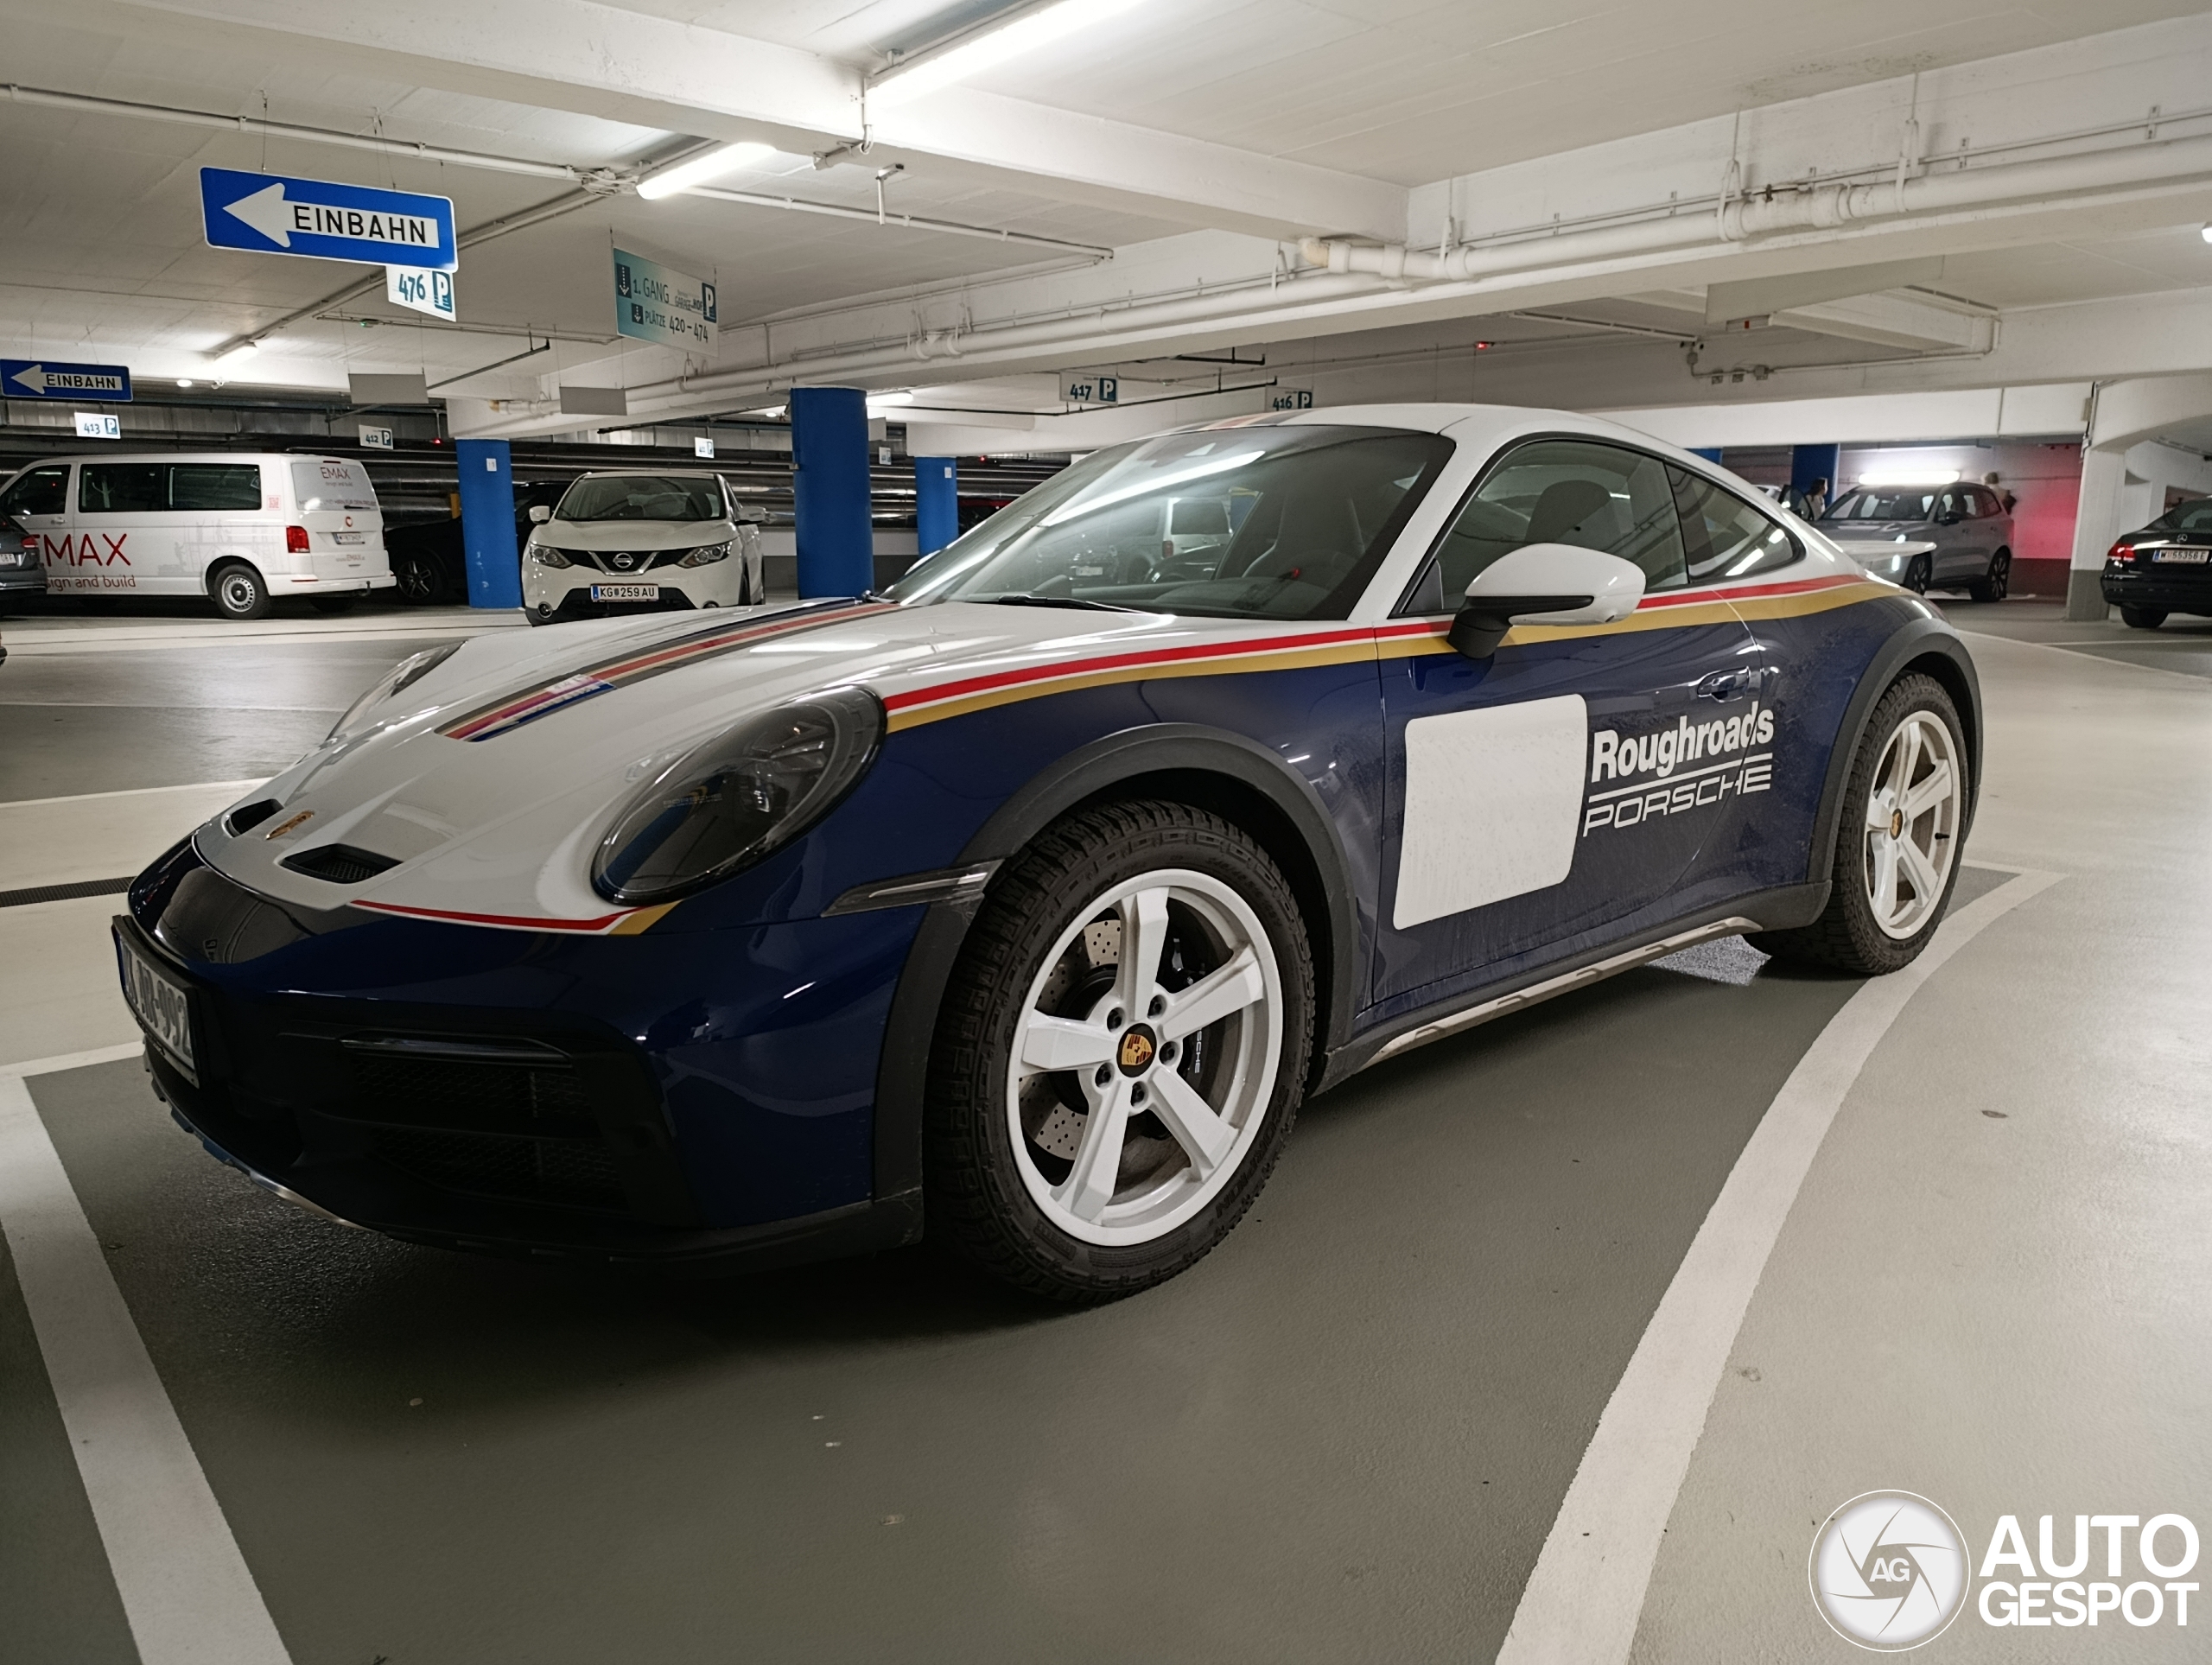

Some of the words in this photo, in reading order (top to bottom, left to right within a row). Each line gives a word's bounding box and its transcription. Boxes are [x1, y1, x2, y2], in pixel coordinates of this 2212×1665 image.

[294, 205, 427, 245] EINBAHN
[398, 273, 426, 302] 476
[632, 278, 641, 295] 1.
[643, 277, 670, 303] GANG
[645, 310, 666, 327] PLÄTZE
[670, 316, 685, 334] 420
[694, 322, 709, 343] 474
[46, 374, 116, 389] EINBAHN
[1070, 384, 1092, 401] 417
[1273, 395, 1293, 411] 416
[84, 423, 100, 435] 413
[365, 434, 378, 443] 412
[320, 467, 351, 479] EMAX
[34, 533, 131, 567] MAX
[75, 575, 99, 588] and
[102, 575, 137, 588] build
[600, 587, 613, 598] KG
[620, 587, 639, 598] 259
[642, 586, 655, 597] AU
[1591, 701, 1774, 784] Roughroads
[1582, 764, 1772, 837] PORSCHE
